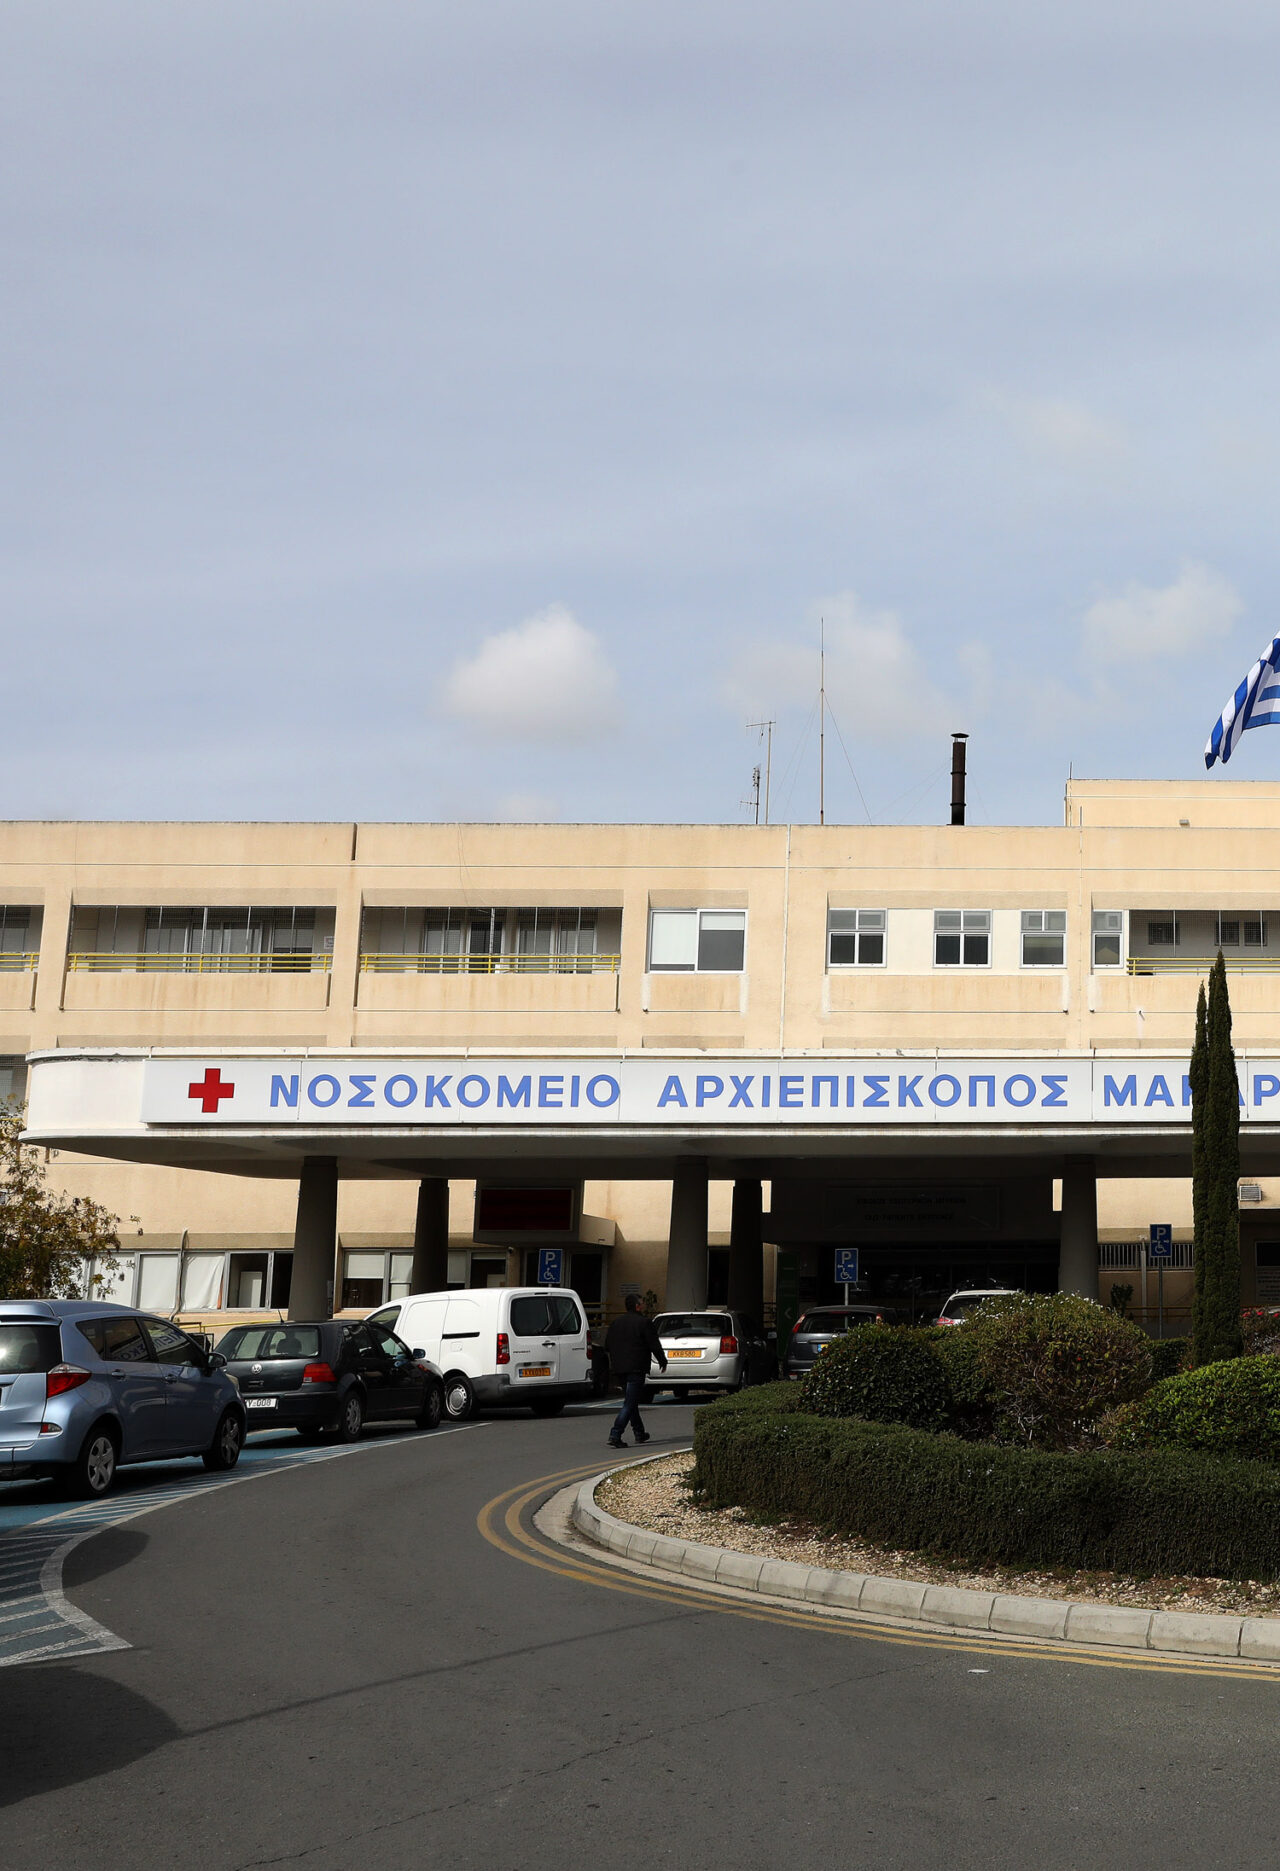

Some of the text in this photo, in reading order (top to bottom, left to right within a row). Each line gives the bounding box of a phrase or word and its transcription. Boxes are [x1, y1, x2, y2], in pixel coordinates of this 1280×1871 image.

[270, 1074, 621, 1108] ΝΟΣΟΚΟΜΕΙΟ
[657, 1073, 1068, 1108] ΑΡΧΙΕΠΙΣΚΟΠΟΣ
[1156, 1227, 1167, 1240] P
[545, 1251, 556, 1265] P
[841, 1251, 852, 1264] P
